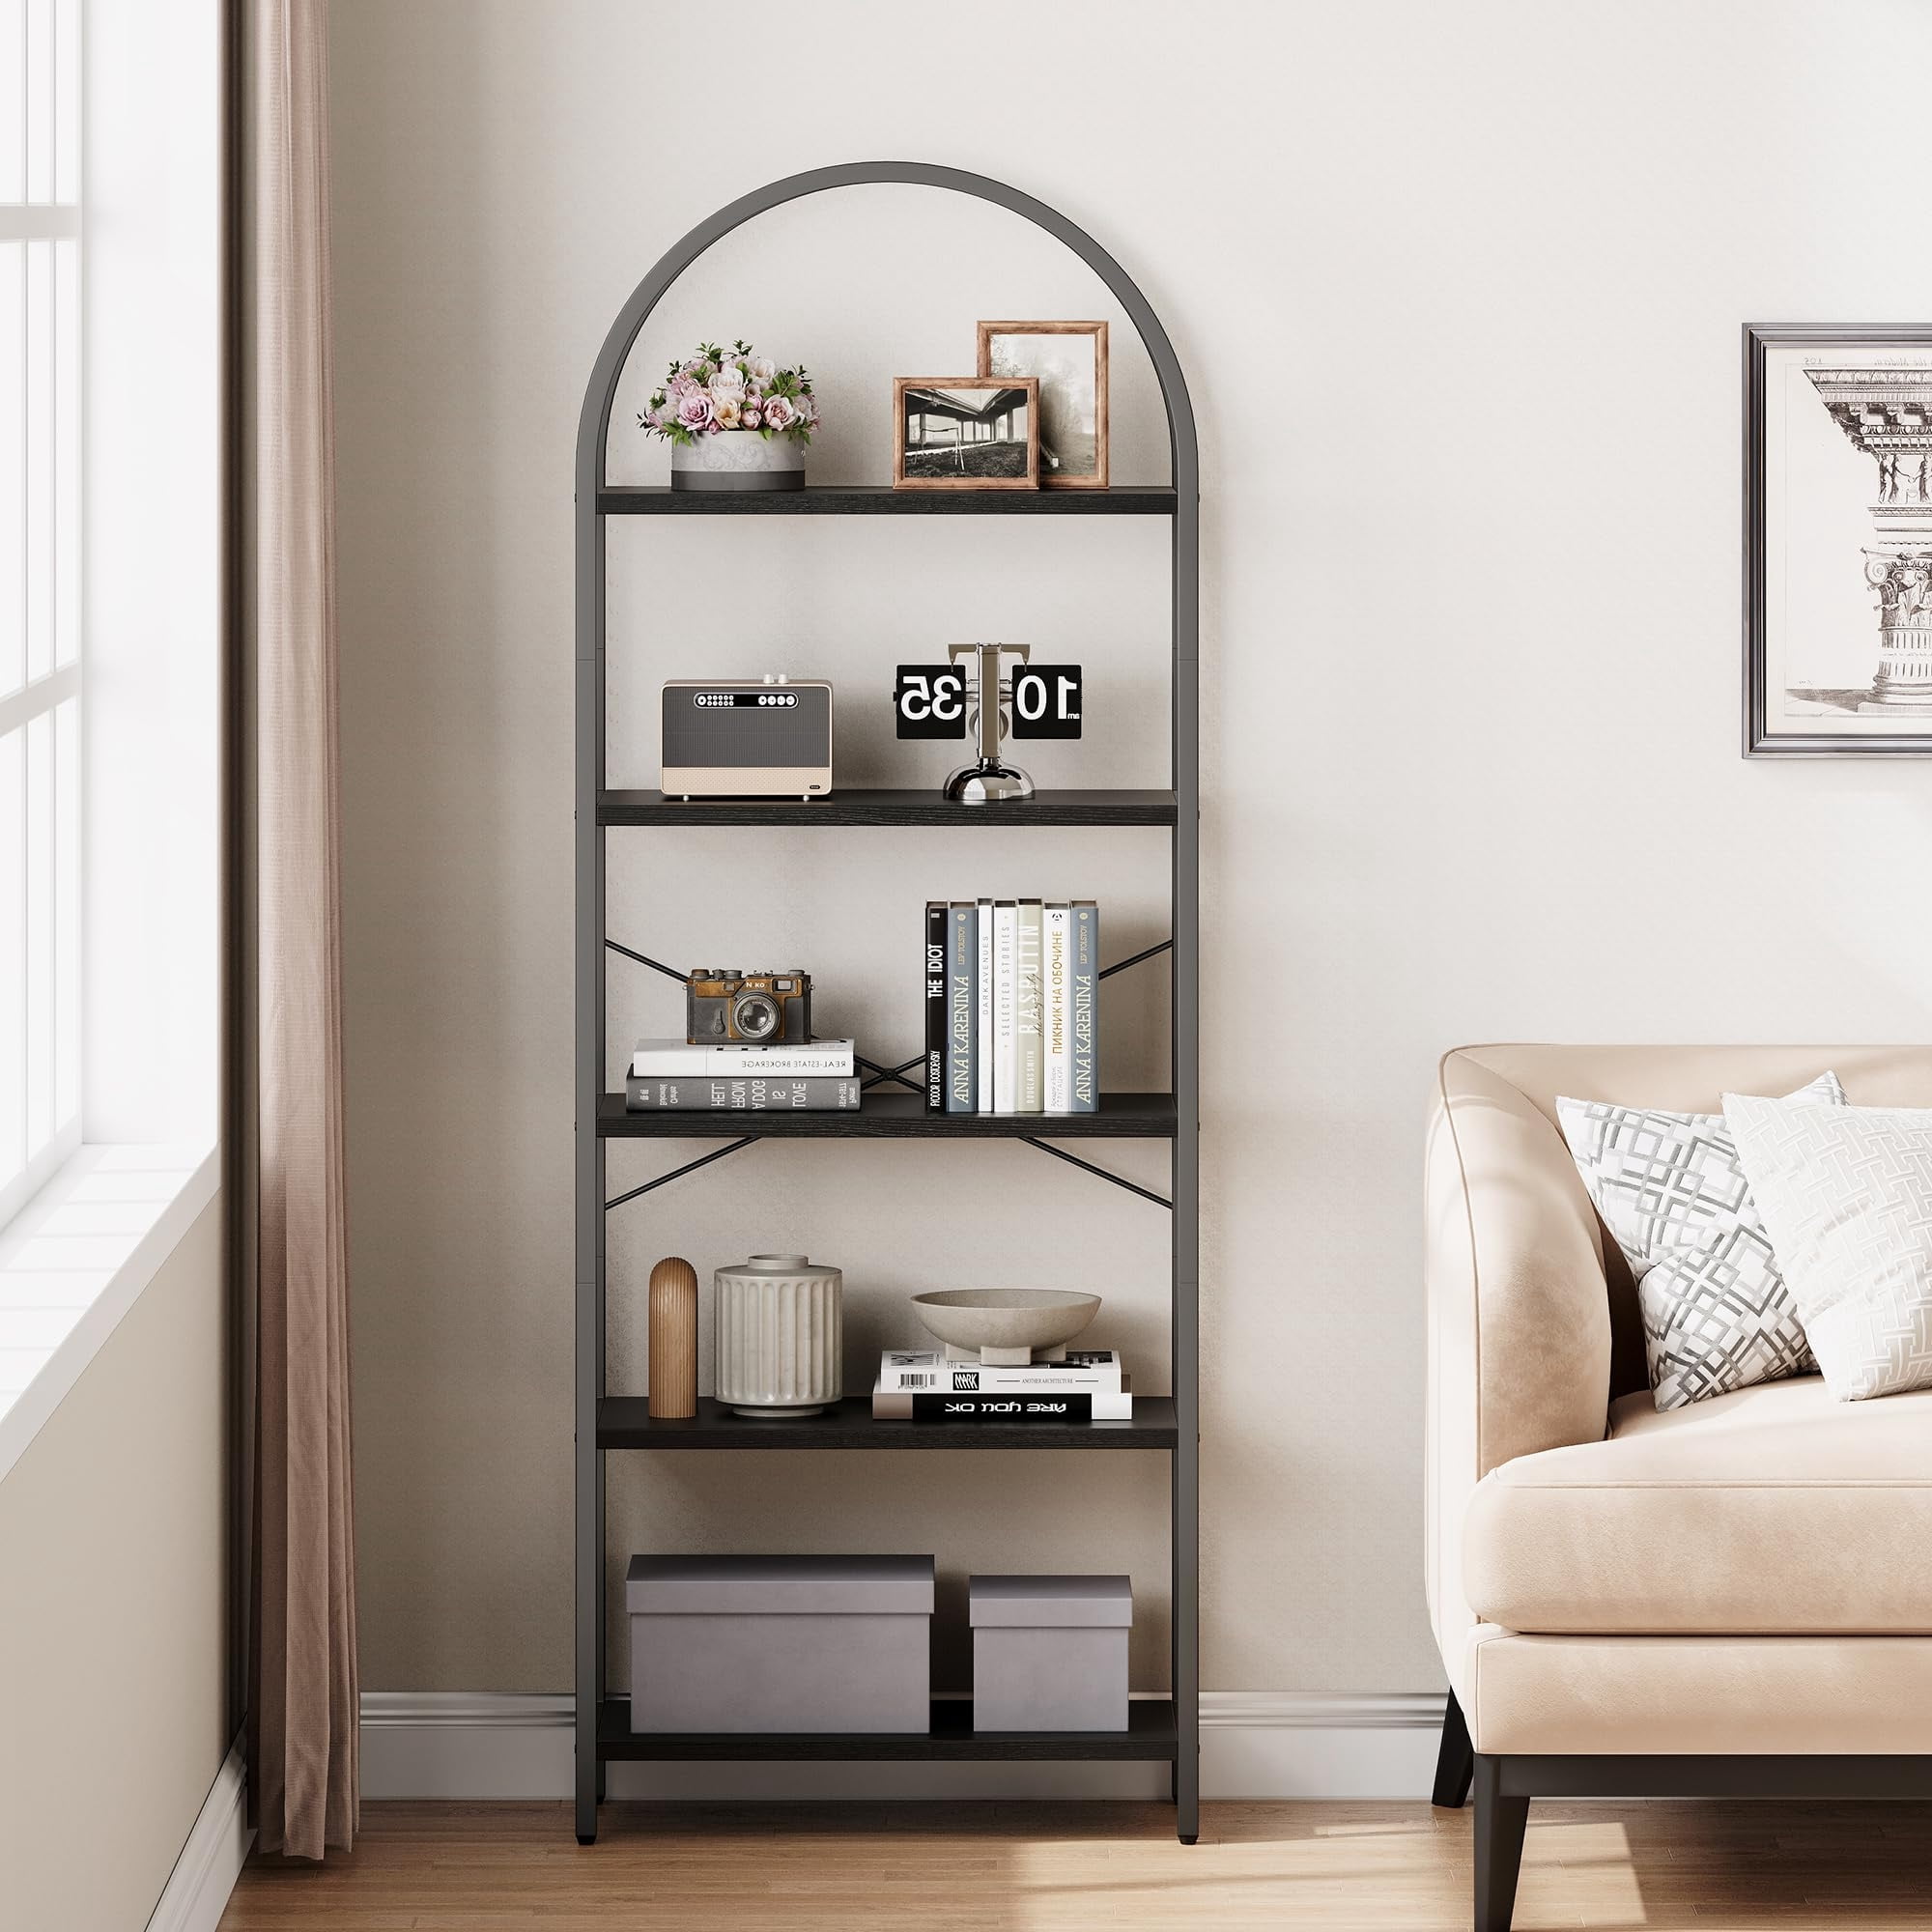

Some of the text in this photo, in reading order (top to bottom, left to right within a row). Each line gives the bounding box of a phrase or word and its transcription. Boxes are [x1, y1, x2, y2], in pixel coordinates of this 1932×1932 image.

[927, 943, 944, 998] THE IDIOT
[1018, 924, 1039, 1035] RASPUTIN
[1051, 930, 1063, 1054] ПИКНИК НА ОБОЧИНЕ
[953, 975, 969, 1104] ANNA KARENINA
[1076, 975, 1091, 1104] ANNA KARENINA
[929, 1085, 941, 1107] FYODOR
[1026, 1050, 1035, 1104] DOUGLAS SMITH
[945, 1403, 974, 1412] OK
[954, 1373, 978, 1390] MARK
